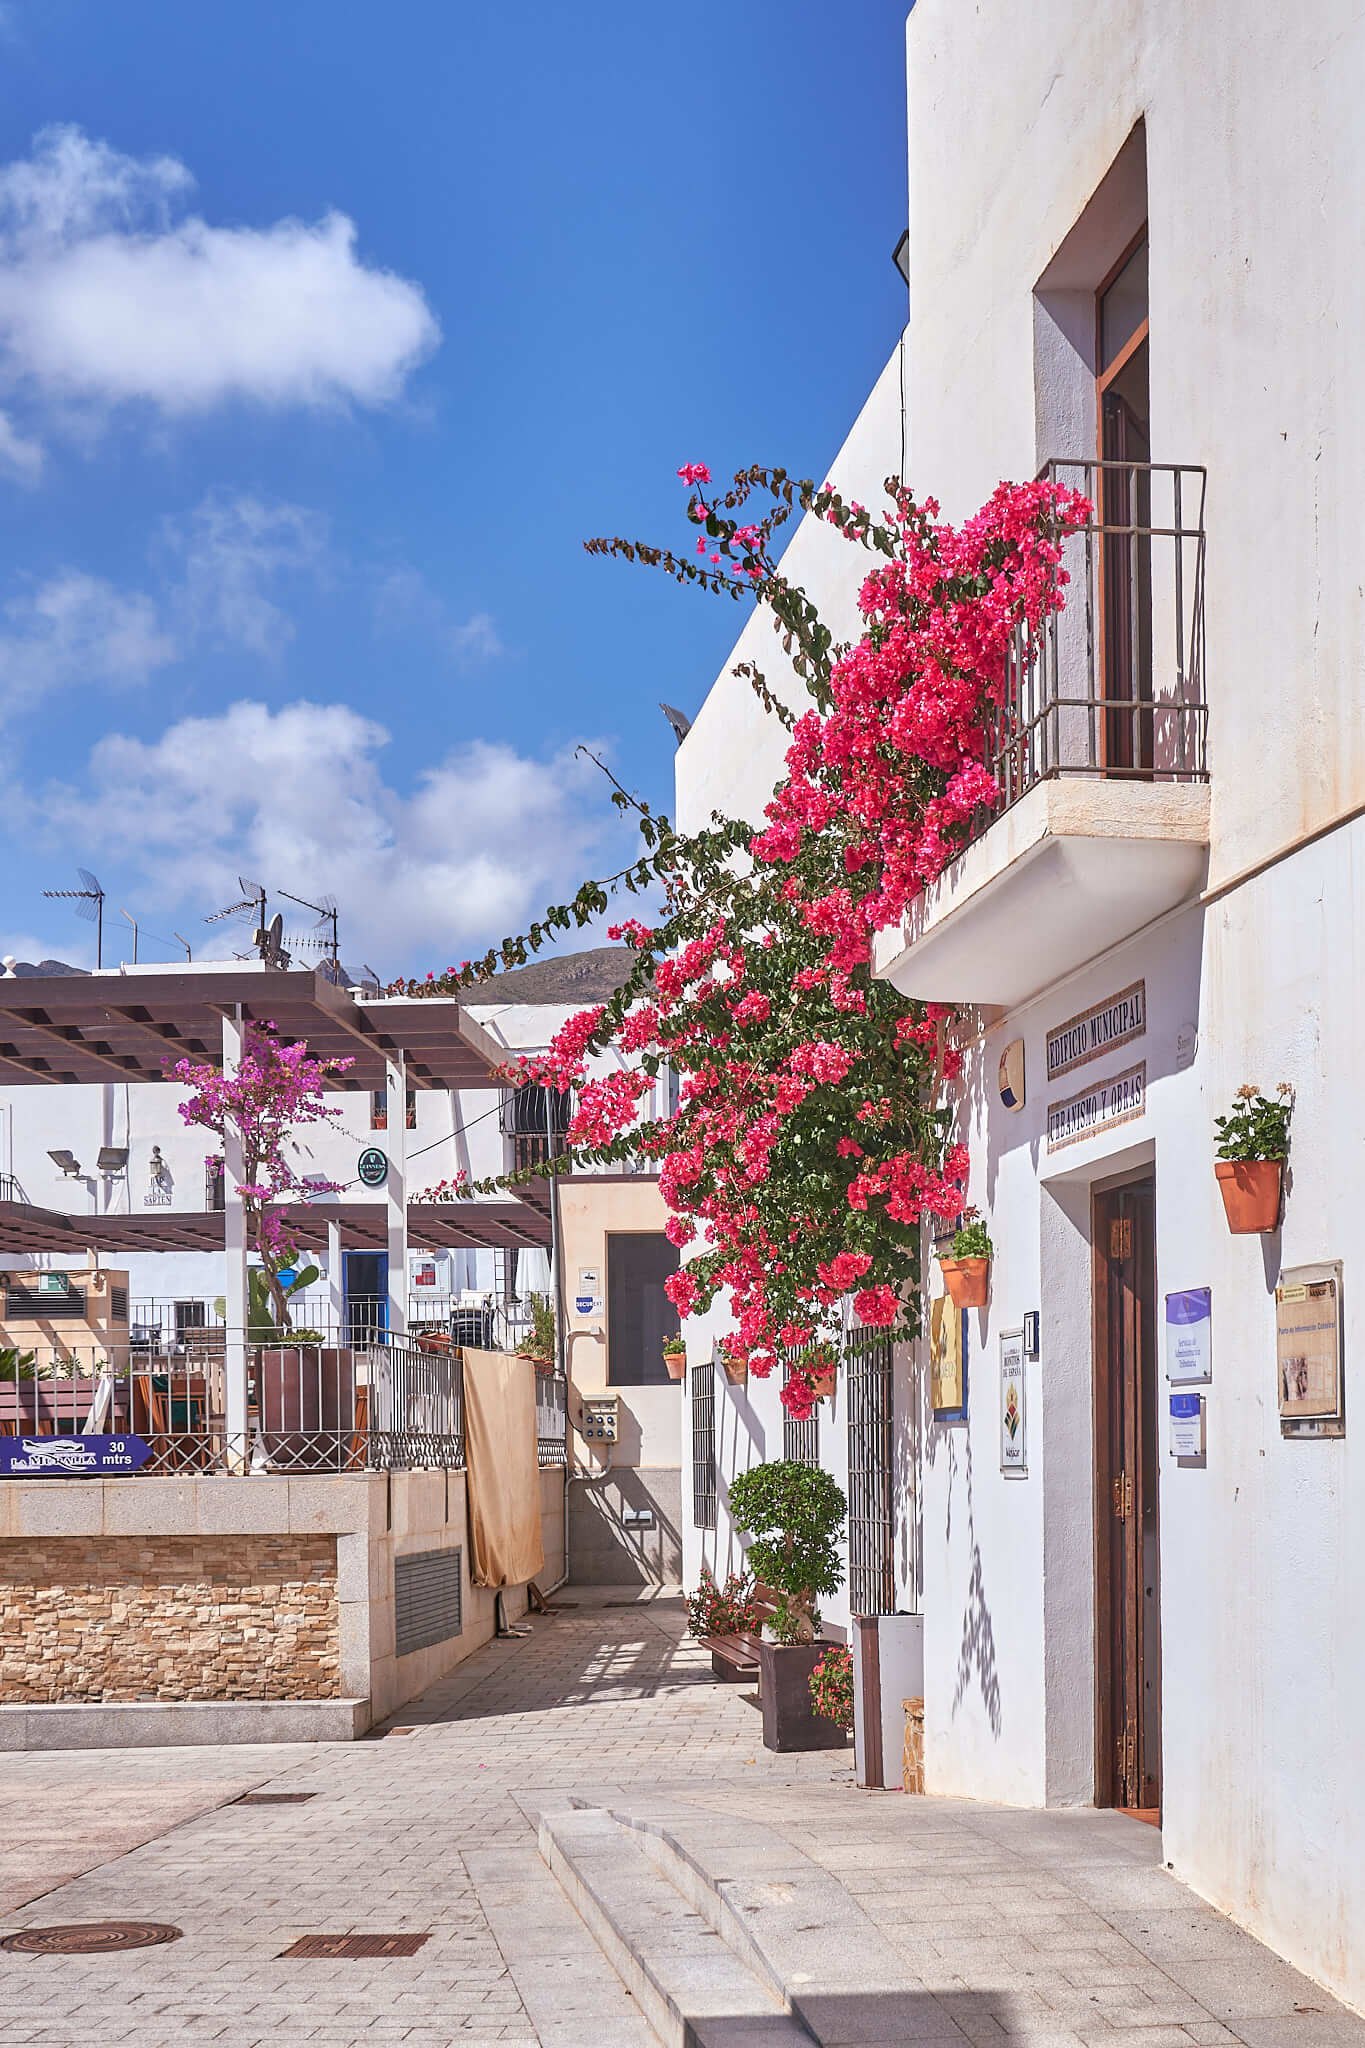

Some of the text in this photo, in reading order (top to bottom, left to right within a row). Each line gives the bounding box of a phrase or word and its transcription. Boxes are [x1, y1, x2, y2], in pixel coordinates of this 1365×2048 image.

[1049, 994, 1142, 1069] EDIFICIO MUNICIPAL
[1050, 1075, 1142, 1143] URBANISMO Y OBRAS
[102, 1454, 132, 1465] mtrs
[109, 1441, 125, 1453] 30
